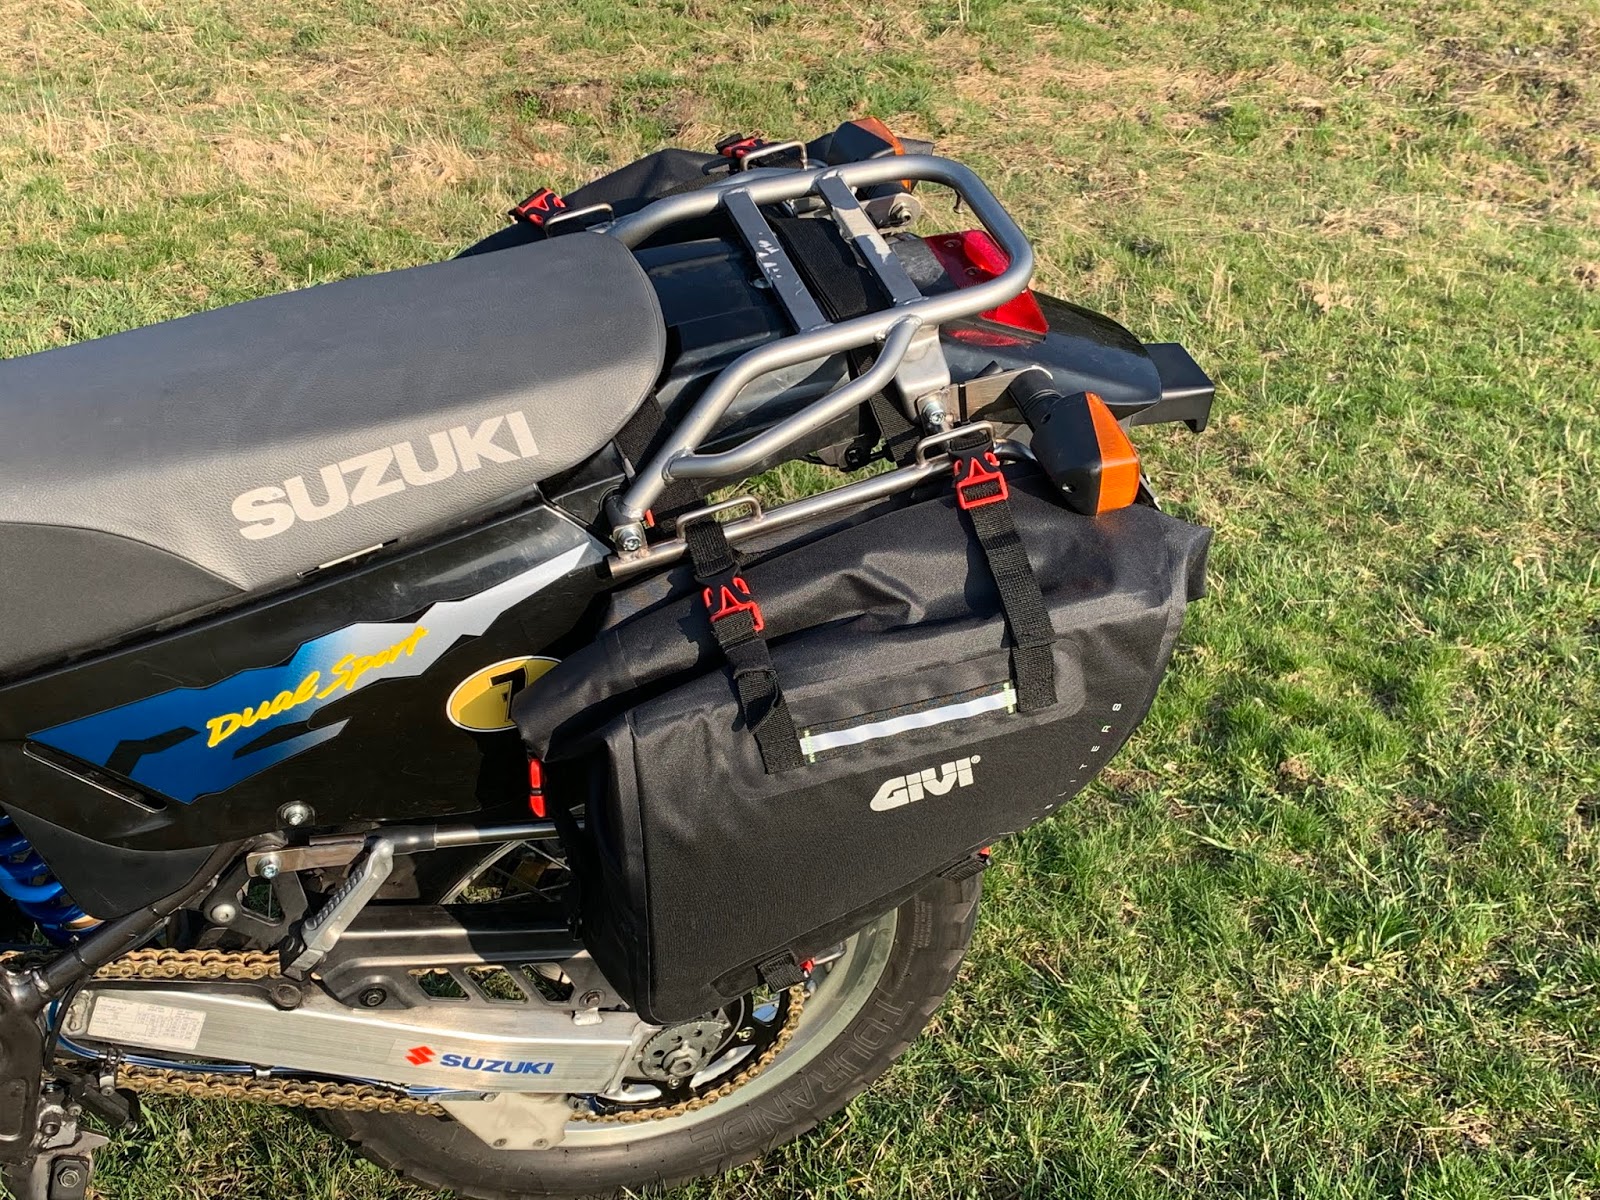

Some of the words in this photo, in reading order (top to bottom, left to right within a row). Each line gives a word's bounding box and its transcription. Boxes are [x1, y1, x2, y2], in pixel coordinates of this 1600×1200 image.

[231, 411, 539, 540] SUZUKI
[206, 671, 320, 748] Dual
[315, 625, 430, 699] Sport
[869, 756, 975, 812] GIVI
[440, 1053, 555, 1075] SUZUKI
[689, 999, 915, 1162] TOURANCE
